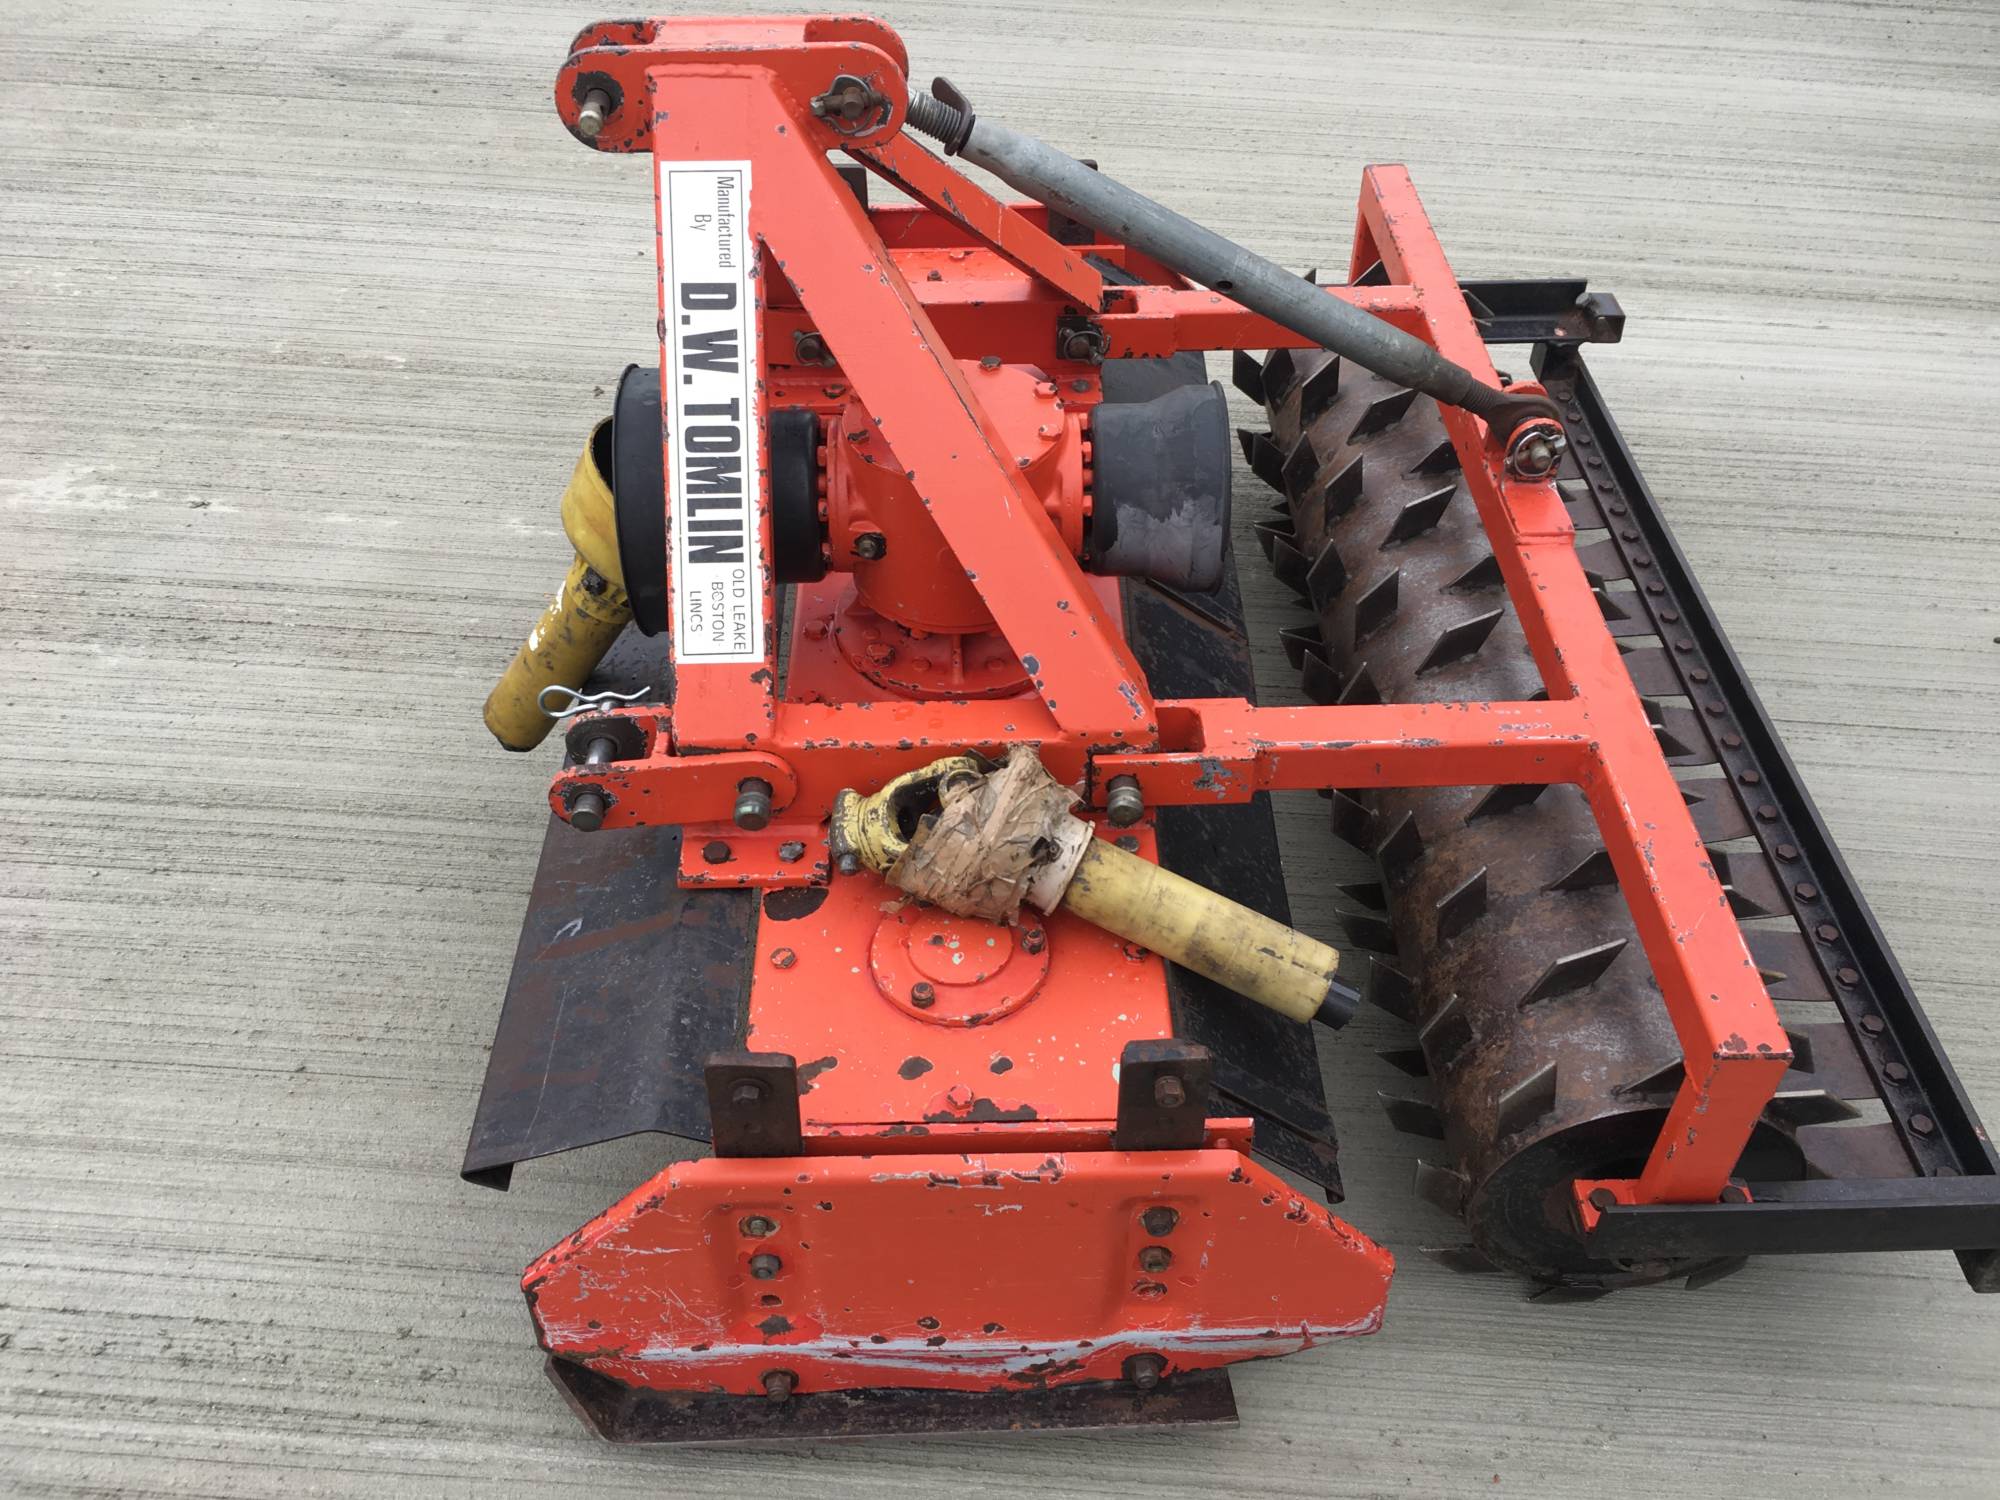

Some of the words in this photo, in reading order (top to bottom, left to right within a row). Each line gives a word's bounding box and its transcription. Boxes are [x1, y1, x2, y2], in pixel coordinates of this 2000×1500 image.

[688, 214, 712, 231] By
[717, 176, 737, 268] Manufactured
[684, 397, 745, 564] TOMLIN
[732, 568, 745, 598] OLD
[689, 590, 703, 632] LINCS
[711, 581, 725, 642] BOSTON
[733, 605, 747, 650] LEAKE
